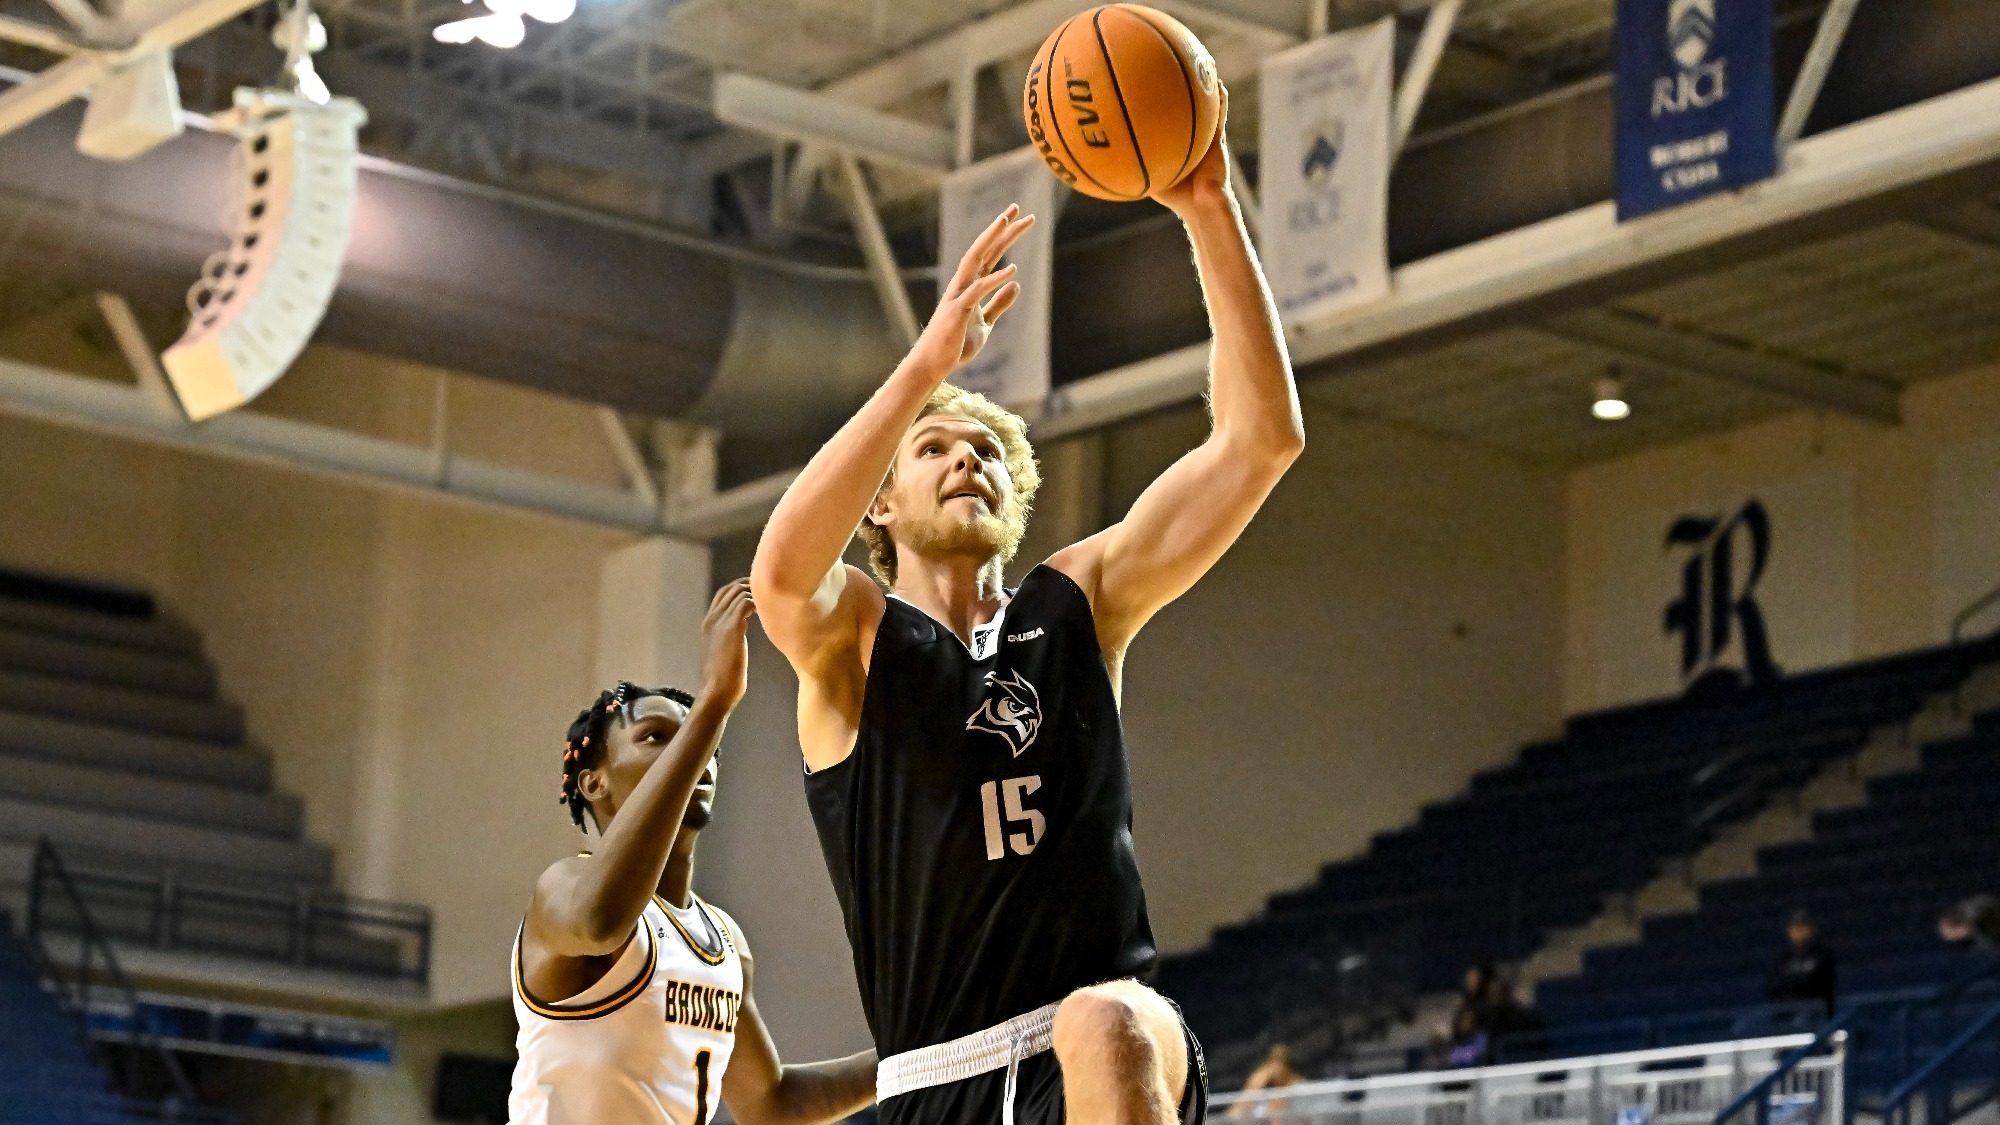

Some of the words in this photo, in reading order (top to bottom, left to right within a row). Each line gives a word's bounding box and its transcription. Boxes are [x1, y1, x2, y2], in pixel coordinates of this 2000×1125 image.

[1066, 80, 1110, 148] EVO
[980, 774, 1047, 861] 15
[691, 1046, 713, 1125] 1
